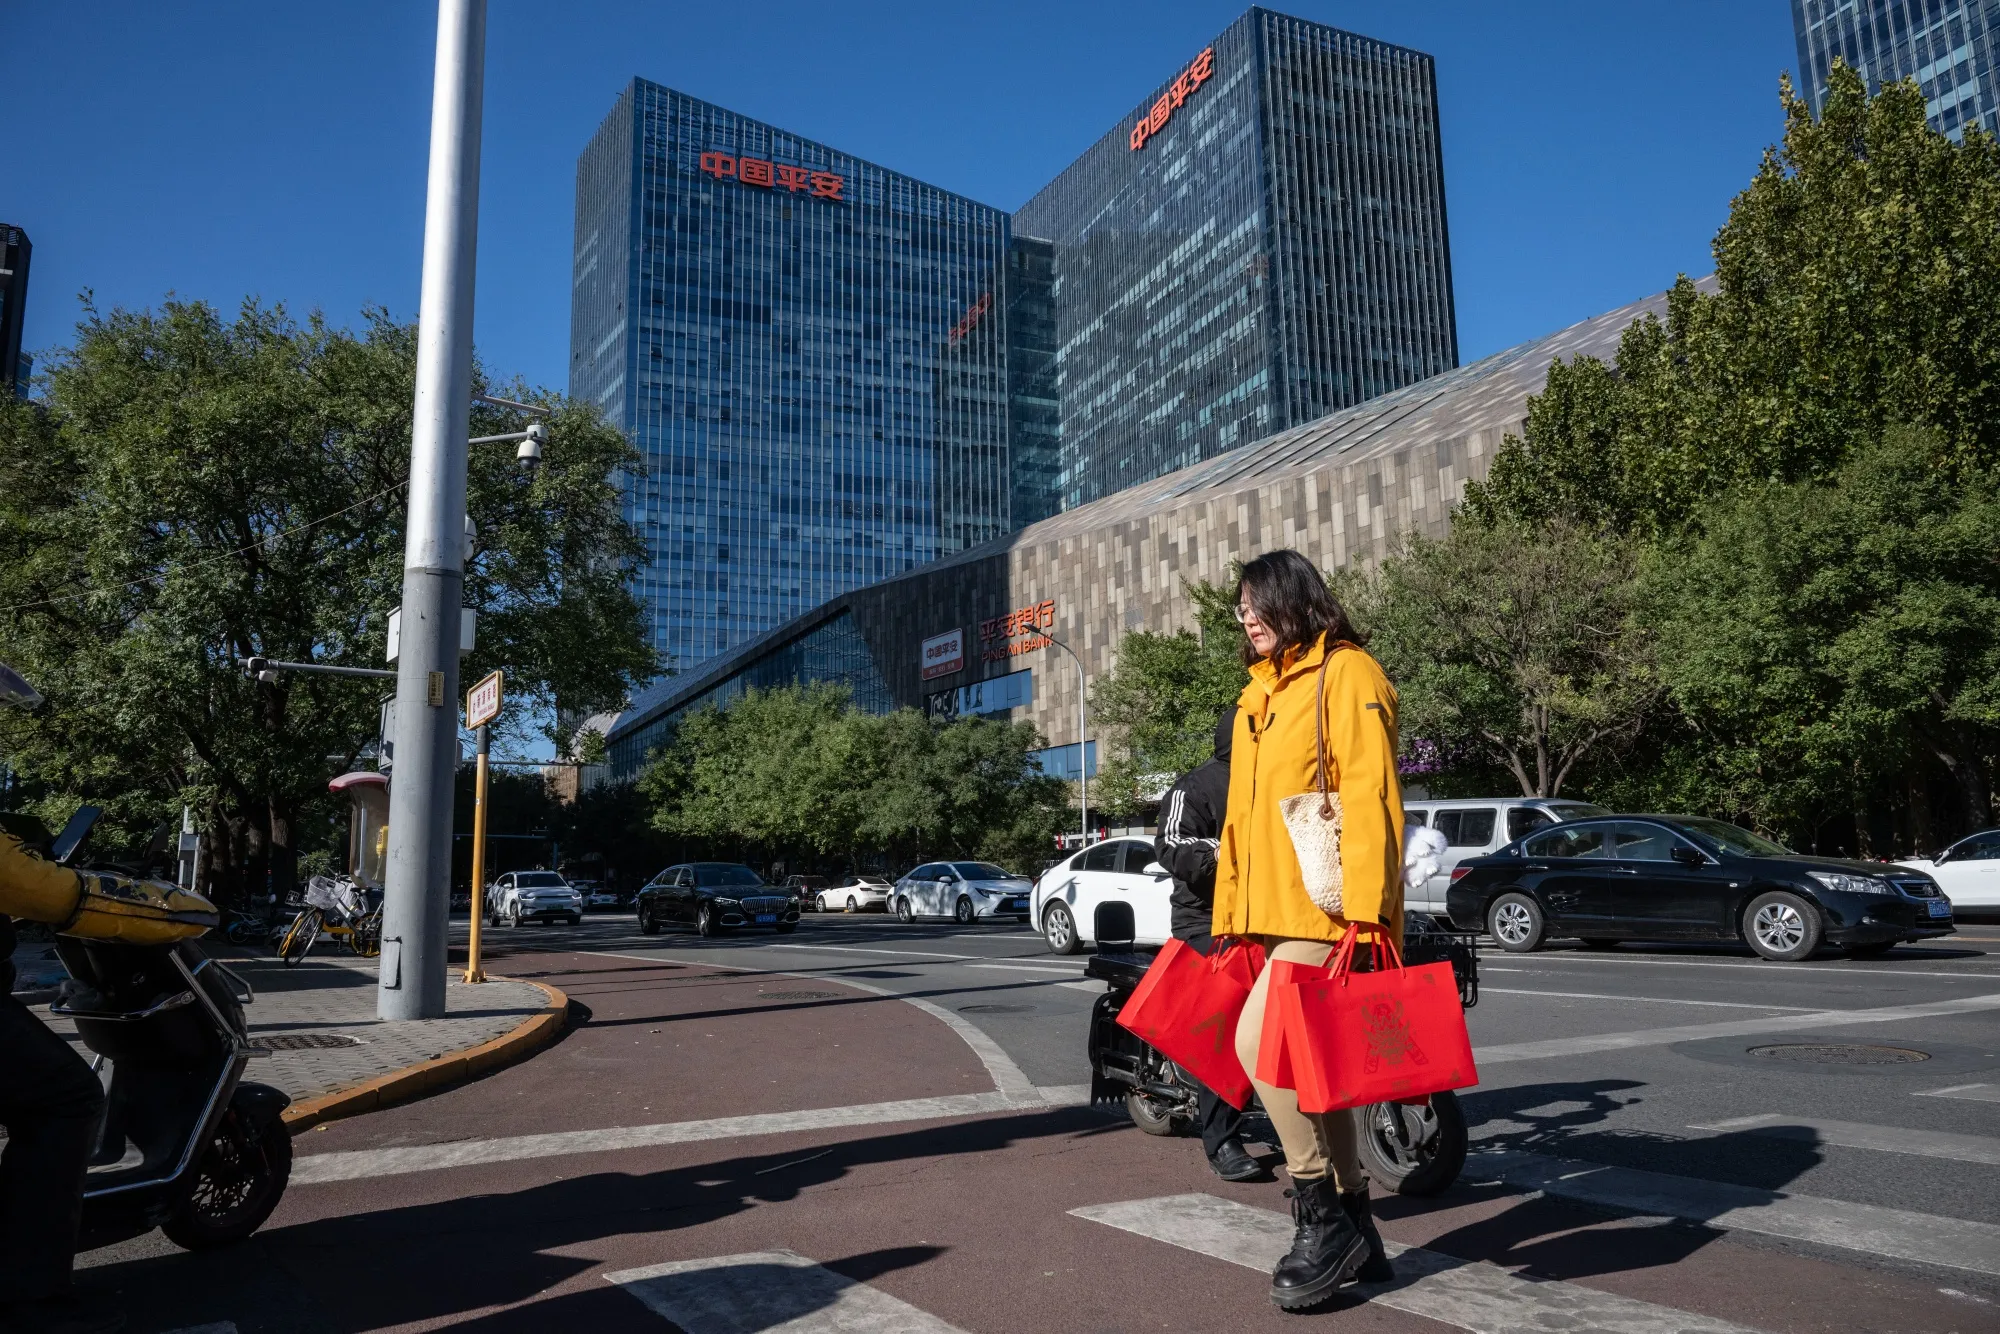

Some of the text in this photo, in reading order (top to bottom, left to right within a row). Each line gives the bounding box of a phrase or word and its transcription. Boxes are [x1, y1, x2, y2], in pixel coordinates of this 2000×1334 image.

[1130, 47, 1212, 151] 中国平安
[700, 151, 844, 201] 中国平安
[980, 599, 1055, 645] 平安银行
[926, 639, 958, 660] 中国平安
